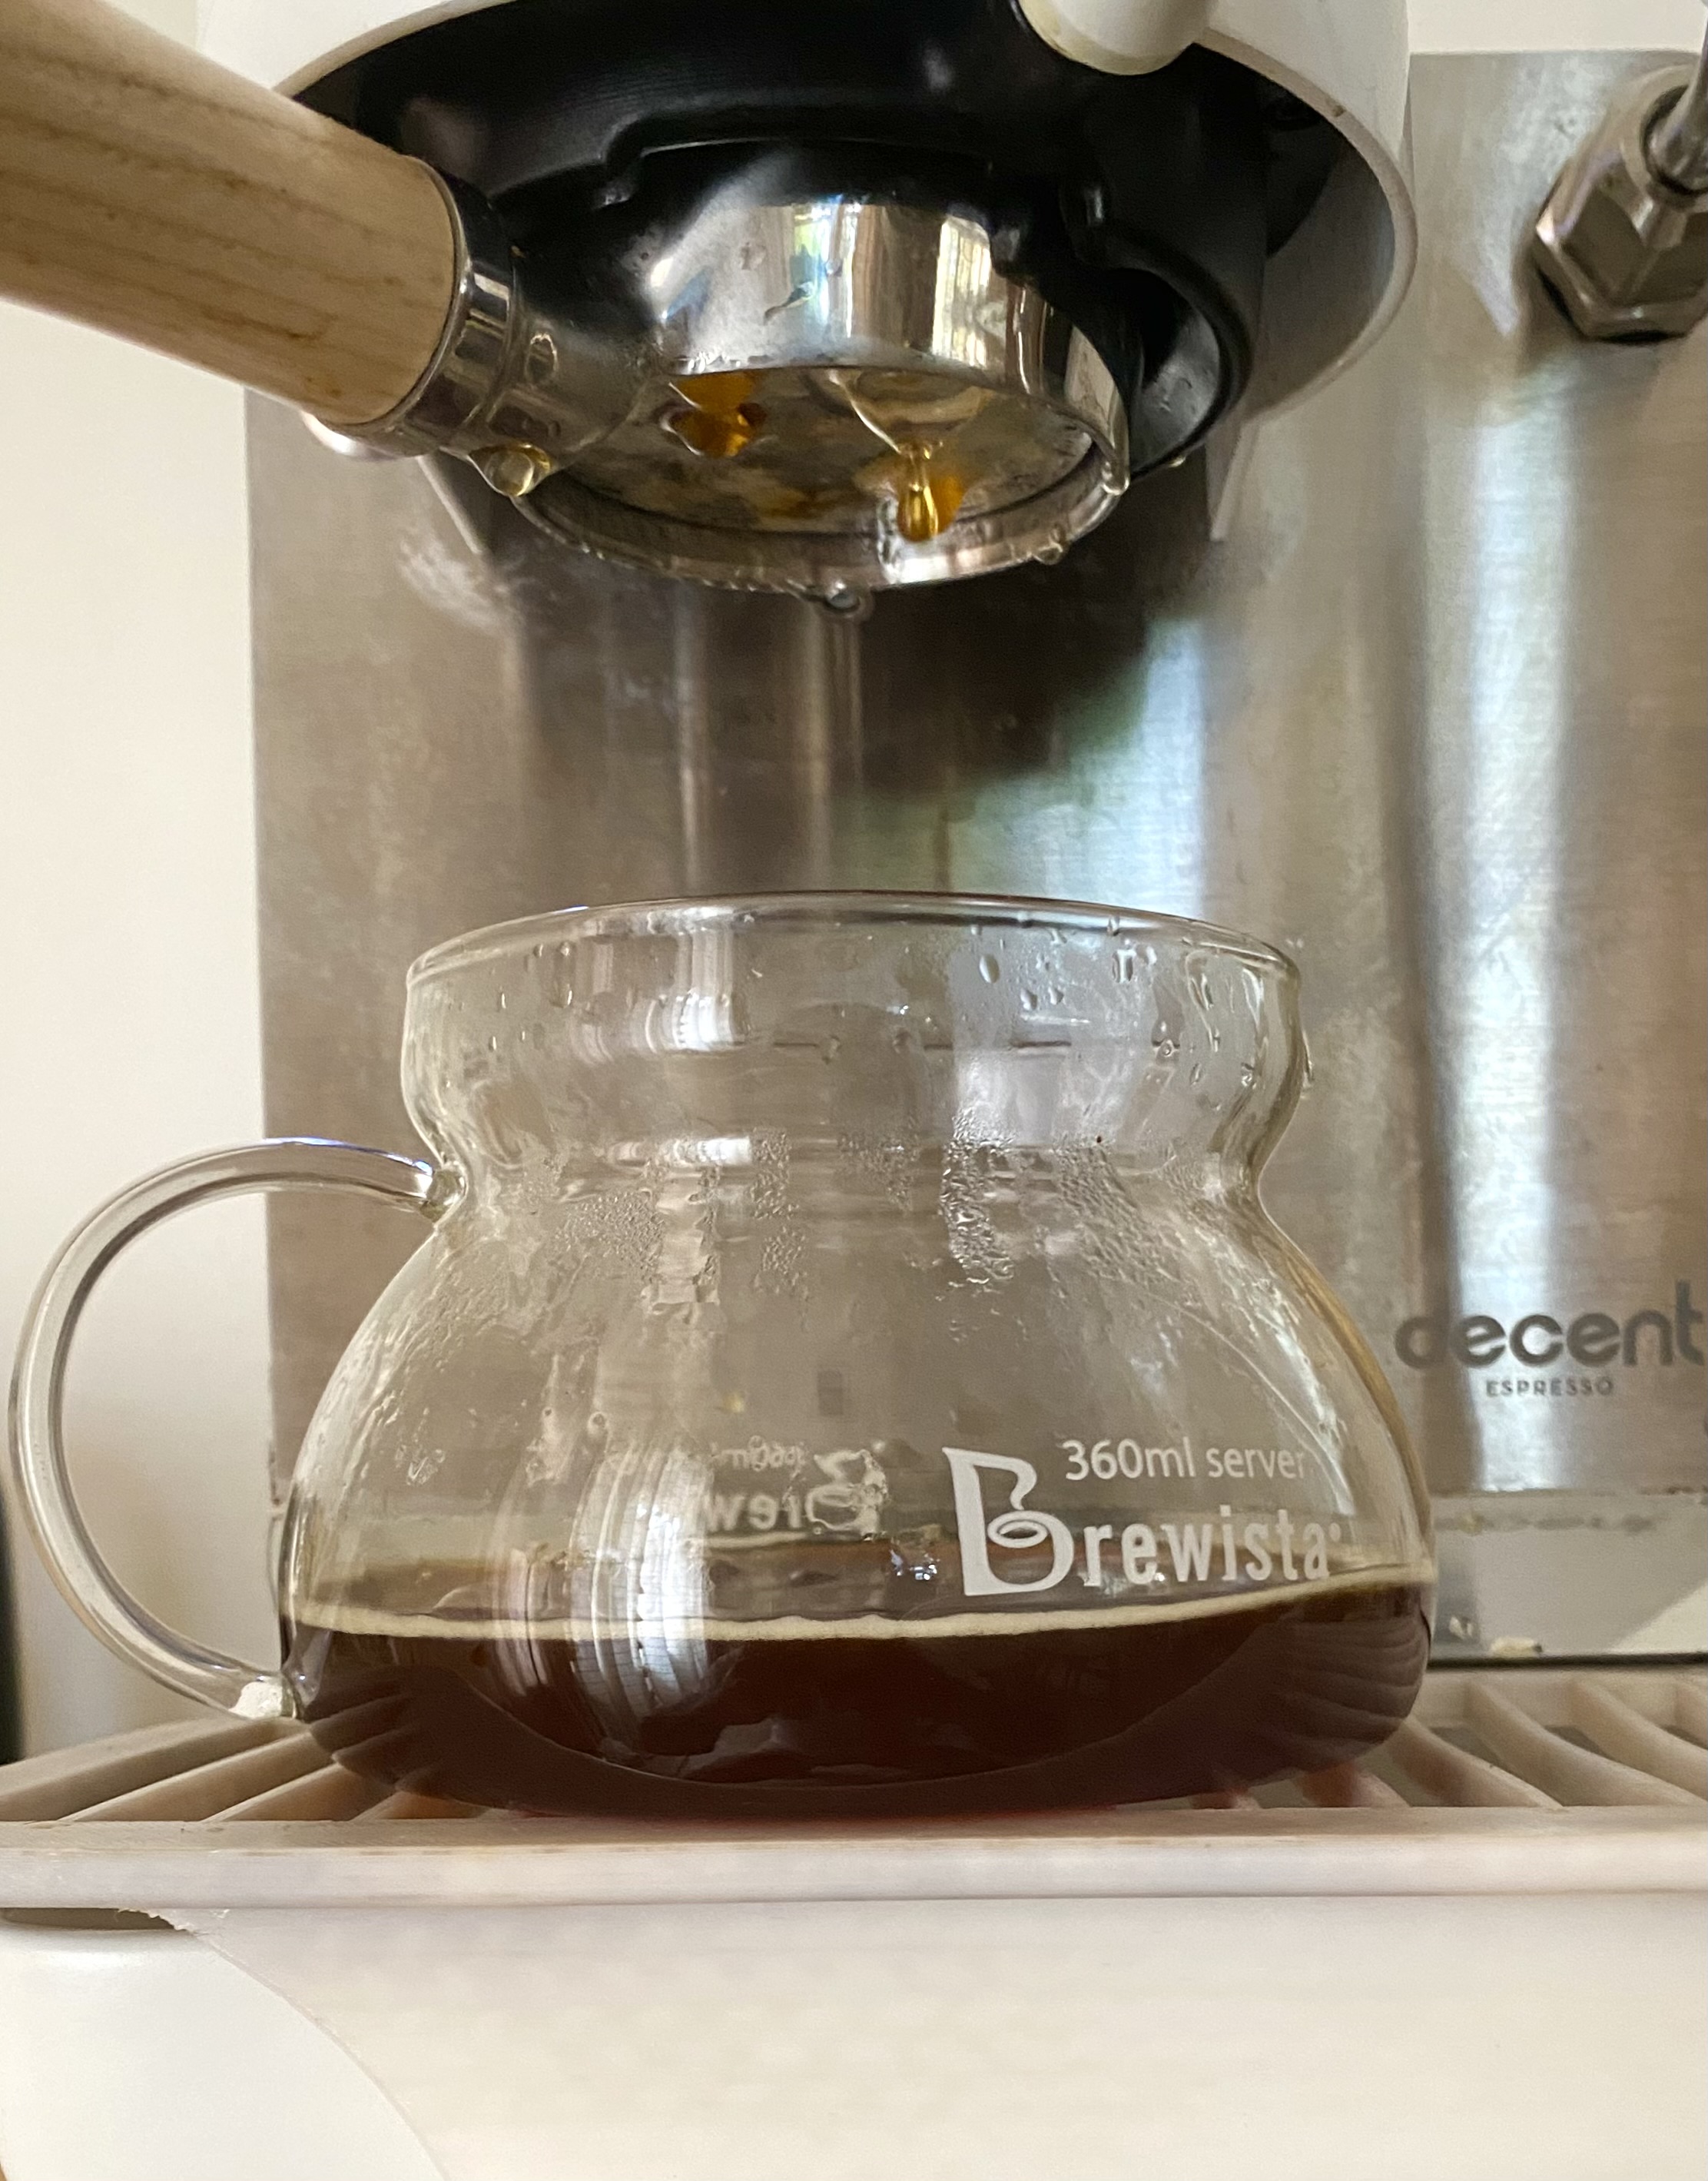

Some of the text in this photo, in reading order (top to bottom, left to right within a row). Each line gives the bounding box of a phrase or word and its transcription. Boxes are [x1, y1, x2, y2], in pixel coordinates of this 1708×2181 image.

[1395, 1280, 1704, 1369] decent
[1485, 1377, 1613, 1398] ESPRESSO
[1061, 1436, 1305, 1481] 360ml server
[942, 1446, 1332, 1596] Brewista
